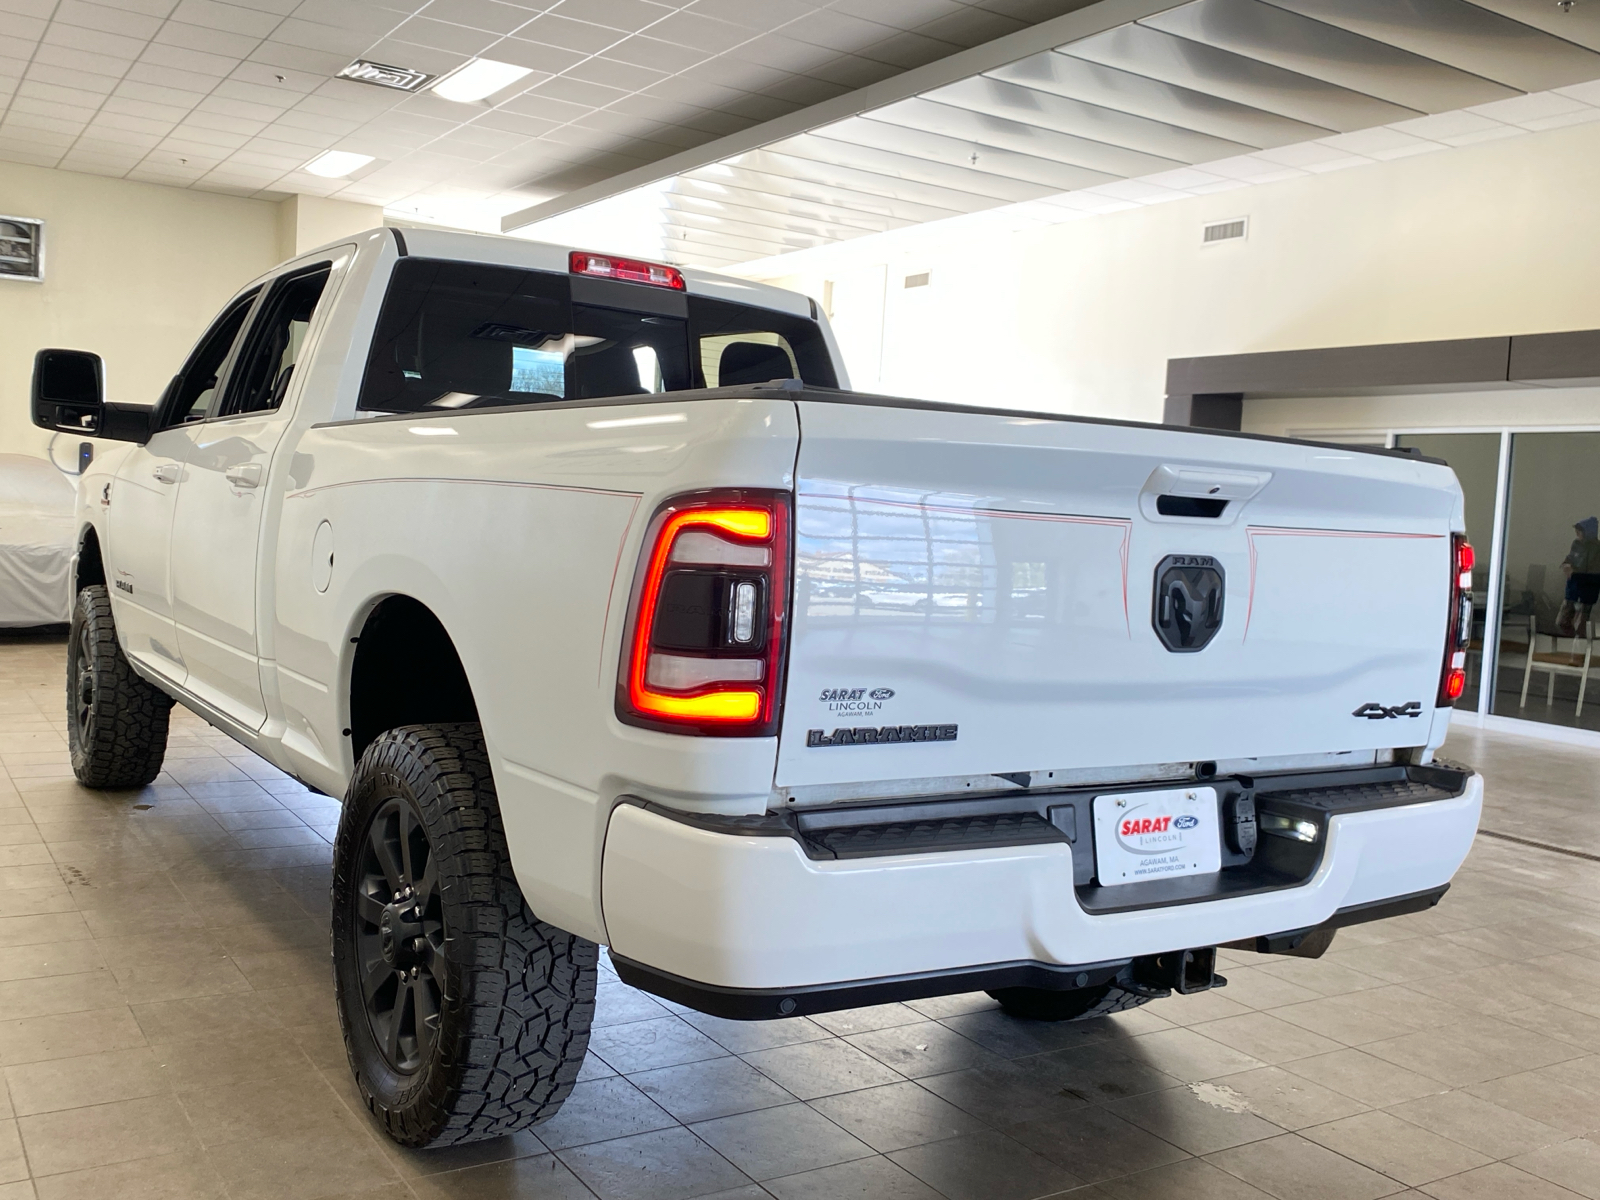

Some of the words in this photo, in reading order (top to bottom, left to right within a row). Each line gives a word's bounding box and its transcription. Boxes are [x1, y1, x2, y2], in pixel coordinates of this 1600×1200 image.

[1171, 556, 1214, 567] RAM
[819, 687, 868, 702] SARAT
[871, 689, 893, 700] Ford
[828, 701, 882, 711] LINCOLN
[837, 710, 864, 718] AGAWAM,
[806, 723, 958, 747] LARAMIE
[1121, 815, 1172, 836] SARAT
[1176, 817, 1196, 829] Ford
[1145, 834, 1178, 844] LINCOLN
[1140, 856, 1169, 867] AGAWAM,
